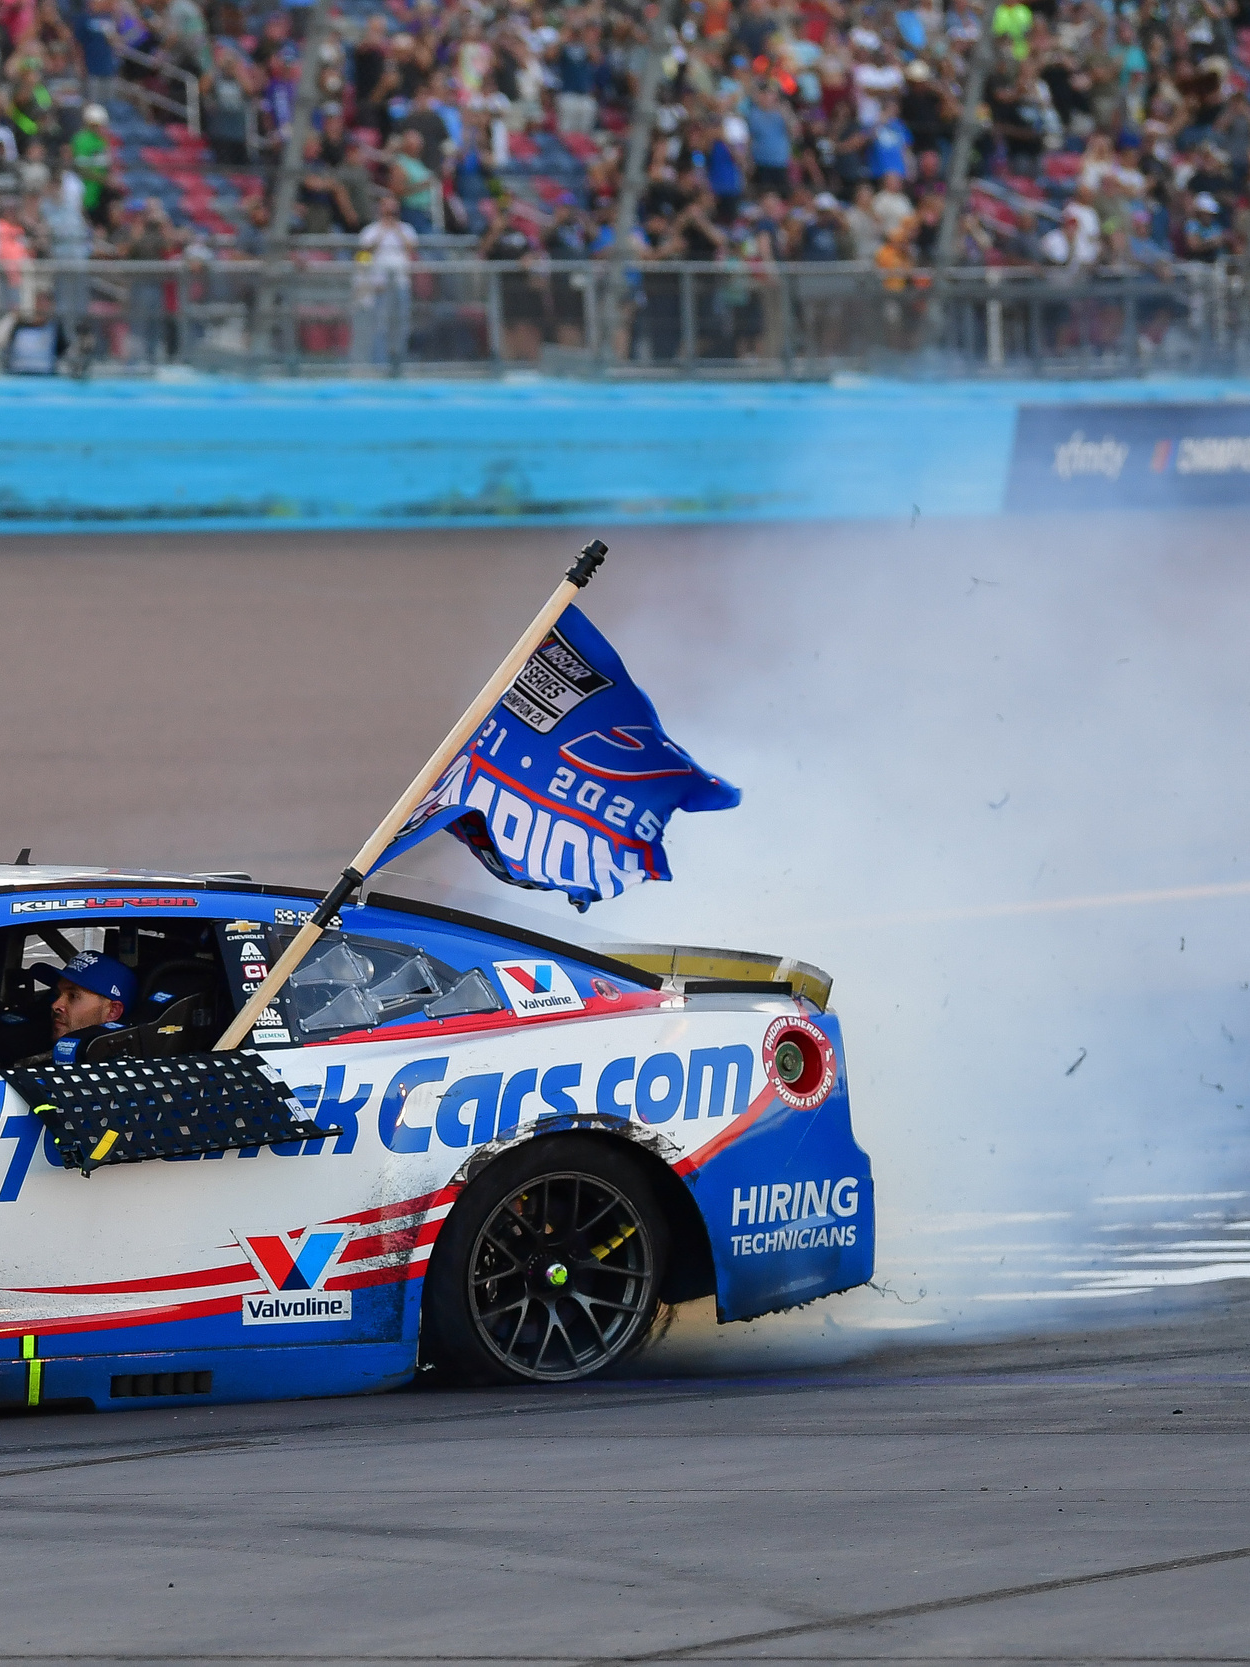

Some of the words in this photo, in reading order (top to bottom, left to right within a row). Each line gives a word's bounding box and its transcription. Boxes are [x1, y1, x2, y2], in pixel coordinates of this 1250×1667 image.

[541, 644, 592, 681] NASCAR
[523, 665, 567, 700] SERIES
[529, 712, 549, 726] 2X
[547, 766, 663, 842] 2025
[518, 996, 572, 1010] Valvoline
[788, 1017, 826, 1041] ENERGY
[732, 1176, 859, 1226] HIRING
[731, 1225, 857, 1257] TECHNICIANS
[247, 1298, 343, 1318] Valvoline
